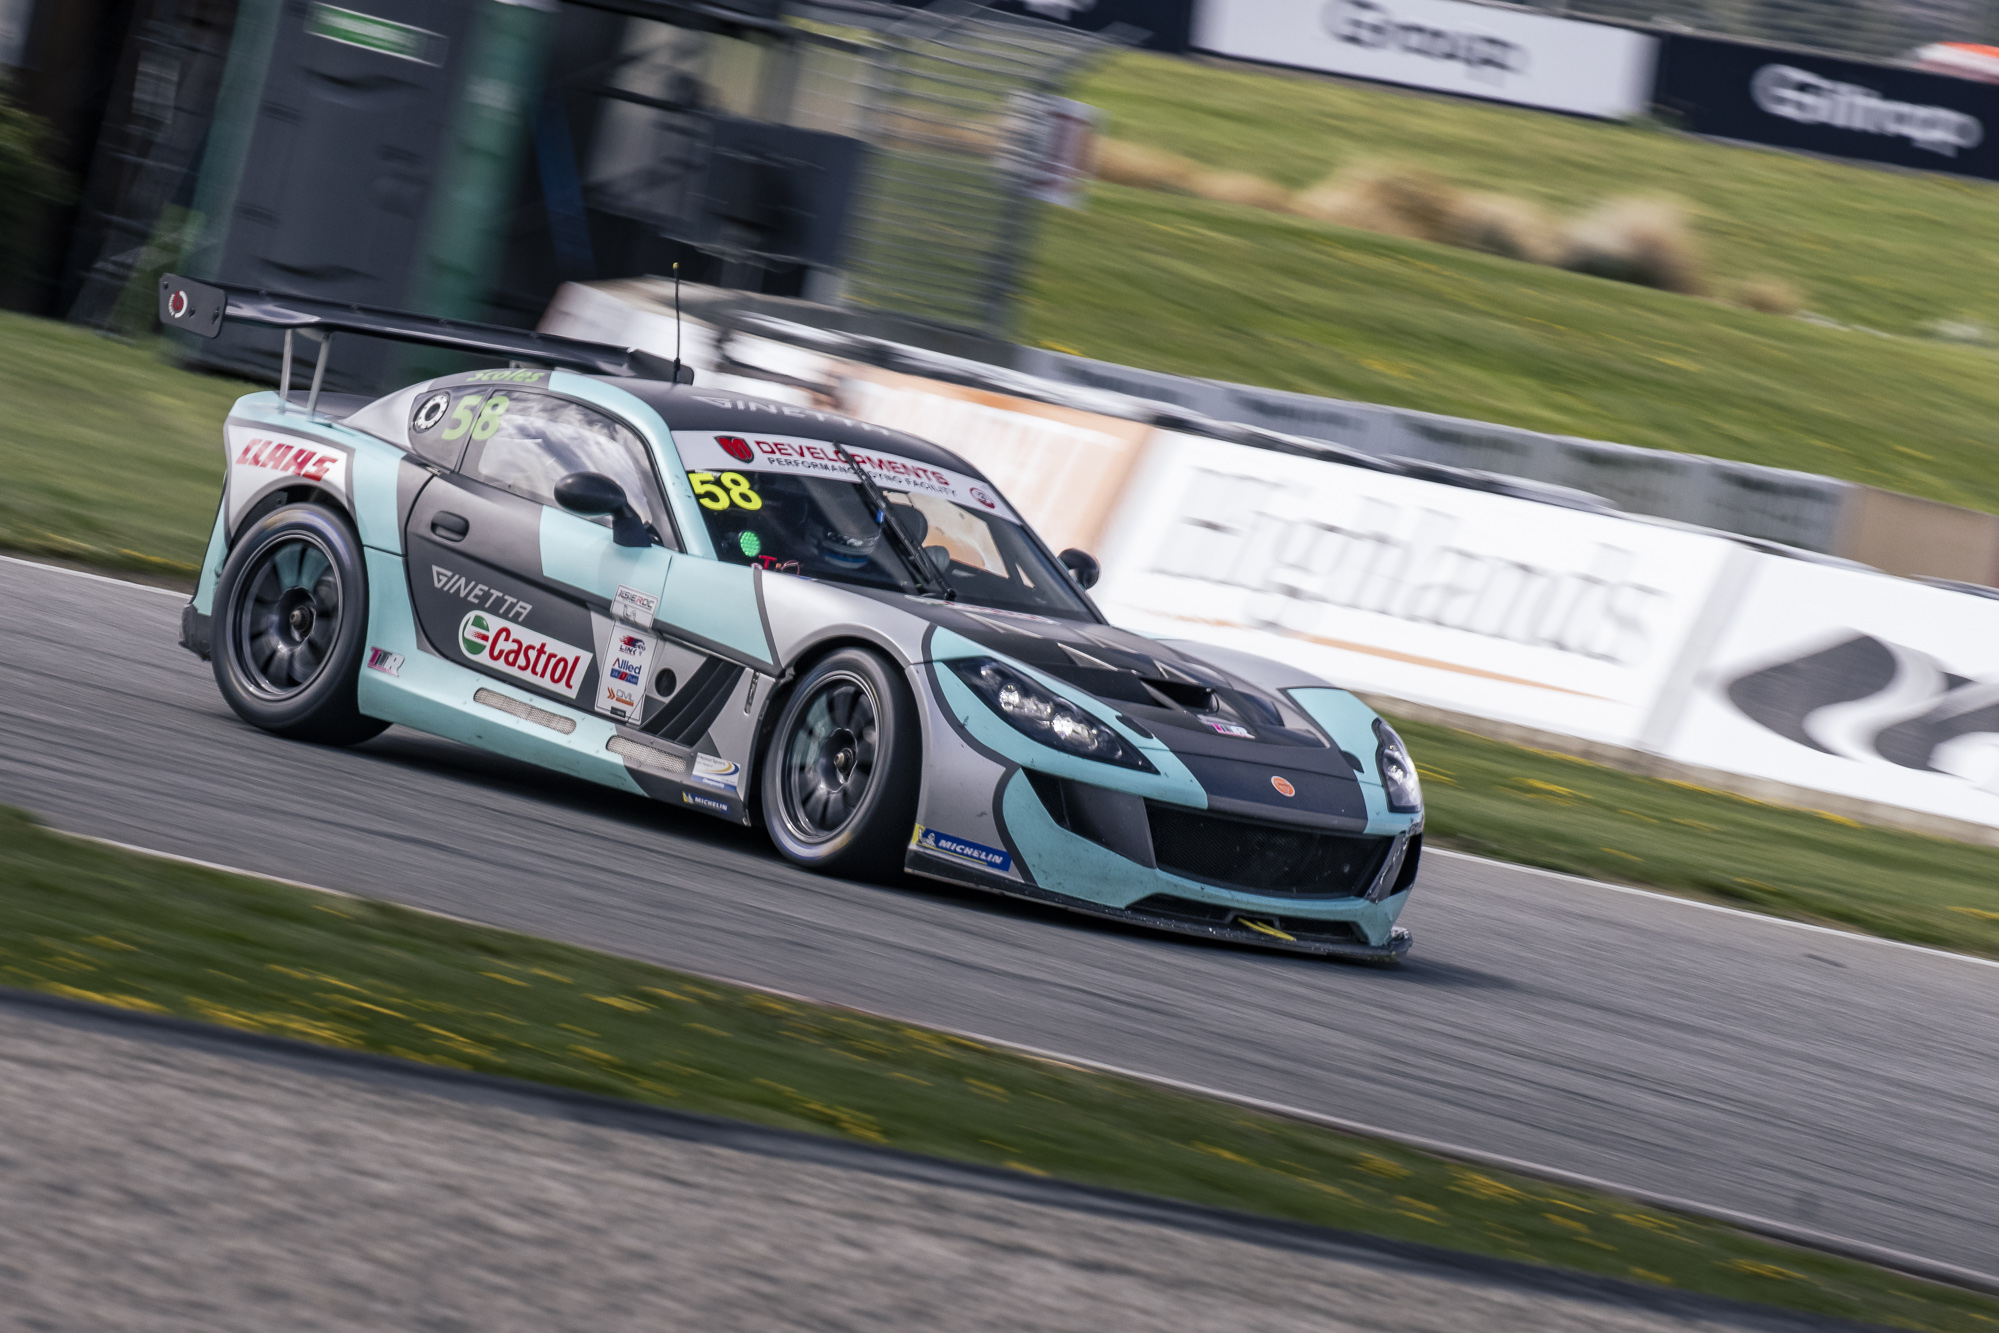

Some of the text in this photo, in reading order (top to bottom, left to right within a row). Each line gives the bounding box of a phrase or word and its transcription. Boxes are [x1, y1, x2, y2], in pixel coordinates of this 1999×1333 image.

[441, 394, 510, 441] 58
[235, 438, 340, 482] CLAAS
[687, 471, 763, 511] 58
[431, 564, 534, 624] GINETTA
[488, 625, 582, 690] Castrol
[612, 657, 642, 675] Allied
[694, 796, 728, 811] MICHELIN
[938, 839, 1004, 865] MICHELIN
